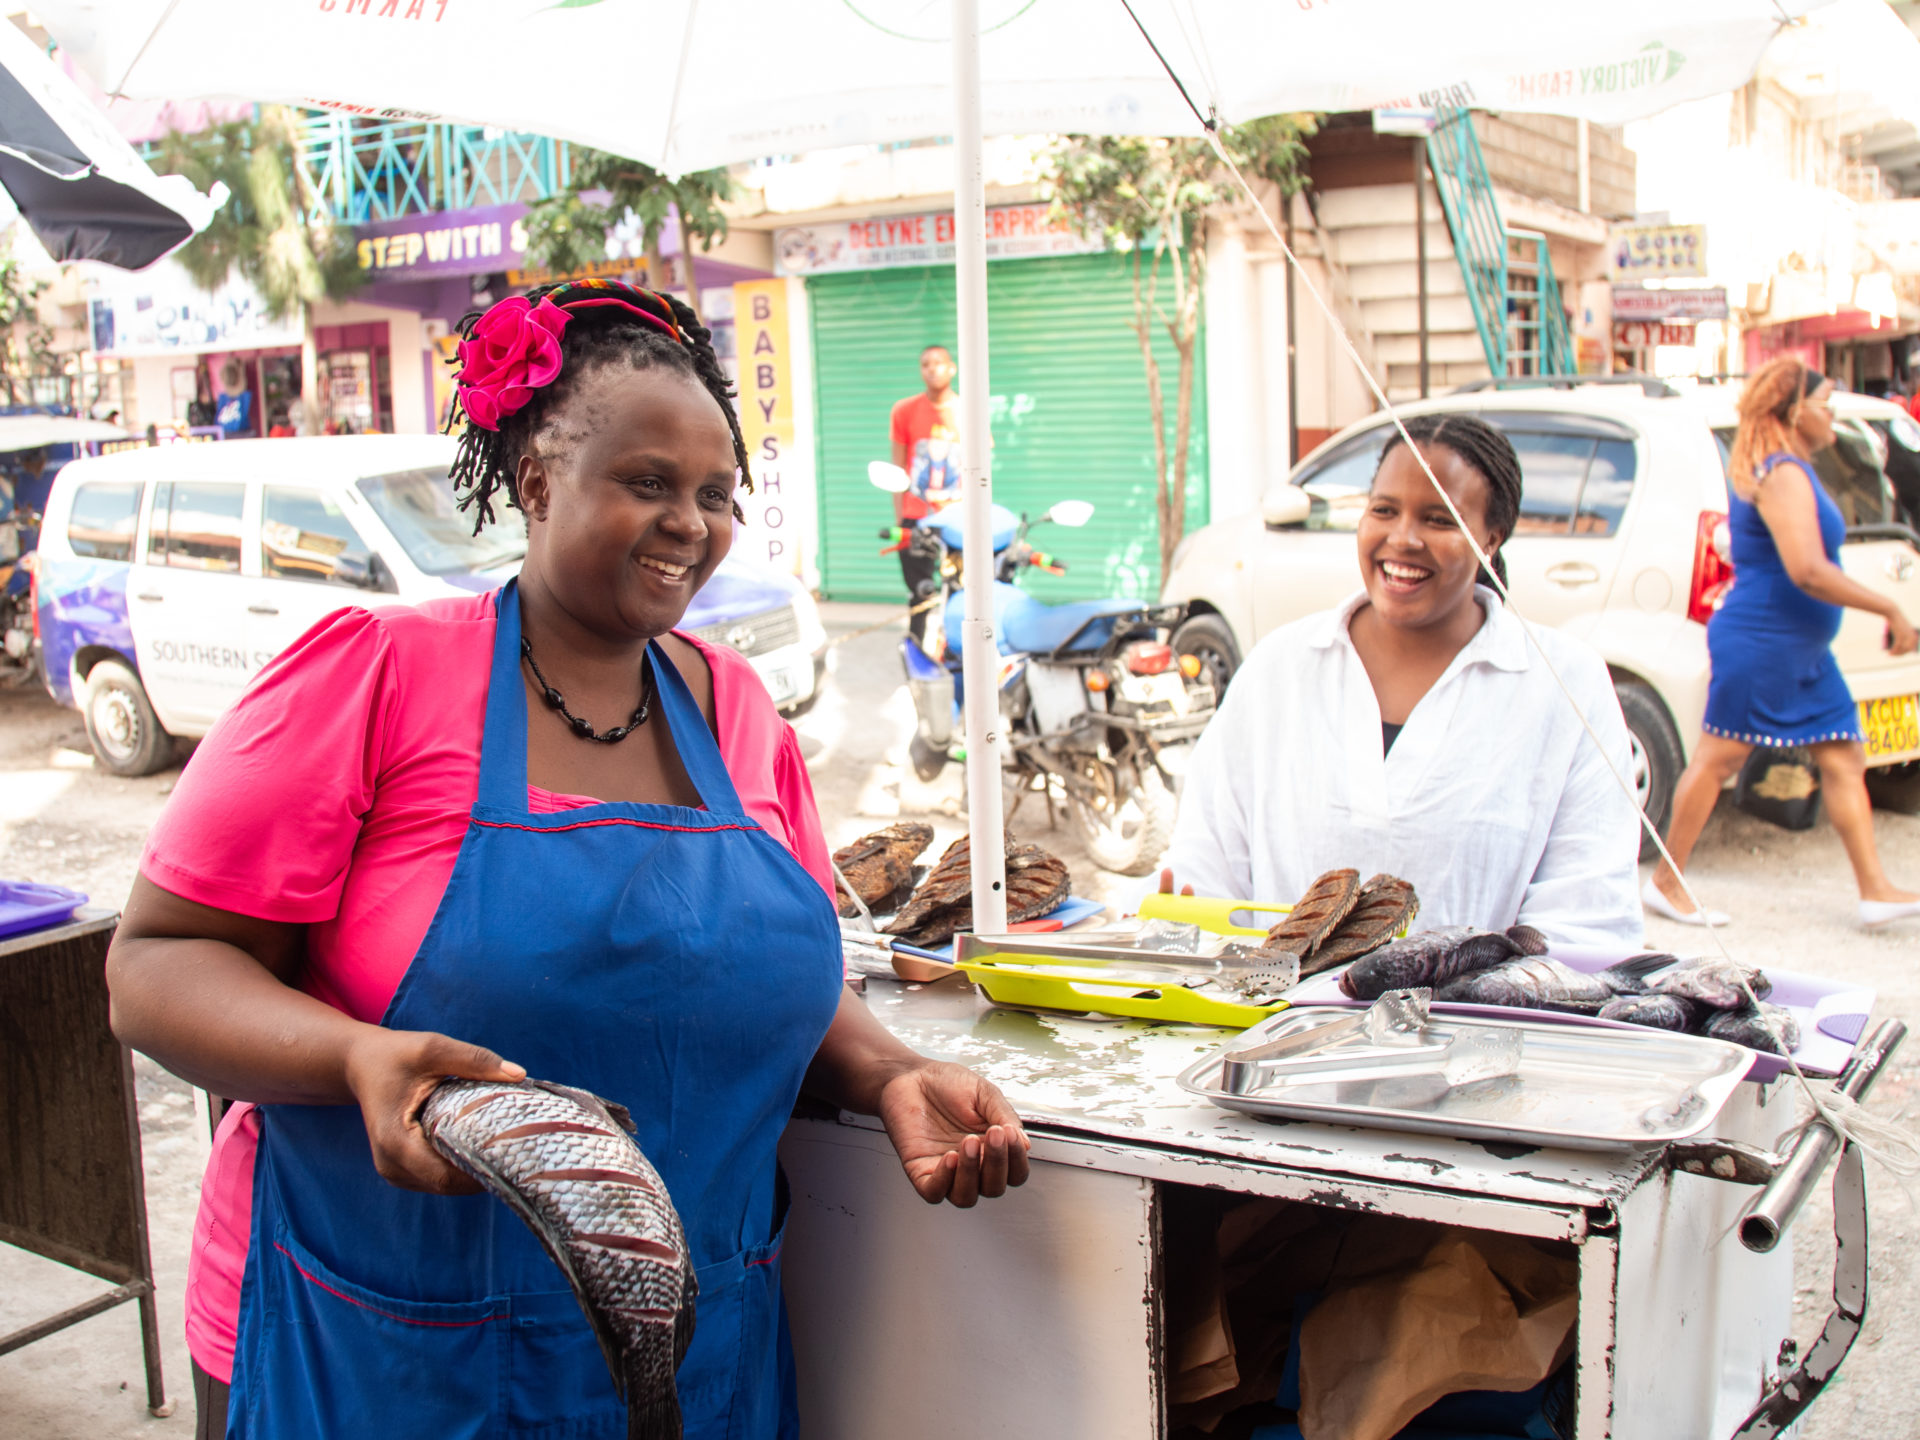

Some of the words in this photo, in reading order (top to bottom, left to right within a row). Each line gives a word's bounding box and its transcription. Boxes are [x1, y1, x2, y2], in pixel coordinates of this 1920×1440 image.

[848, 216, 926, 249] DELYNE
[152, 640, 248, 670] SOUTHERN
[1864, 696, 1902, 726] KCU
[1868, 725, 1919, 755] 840G
